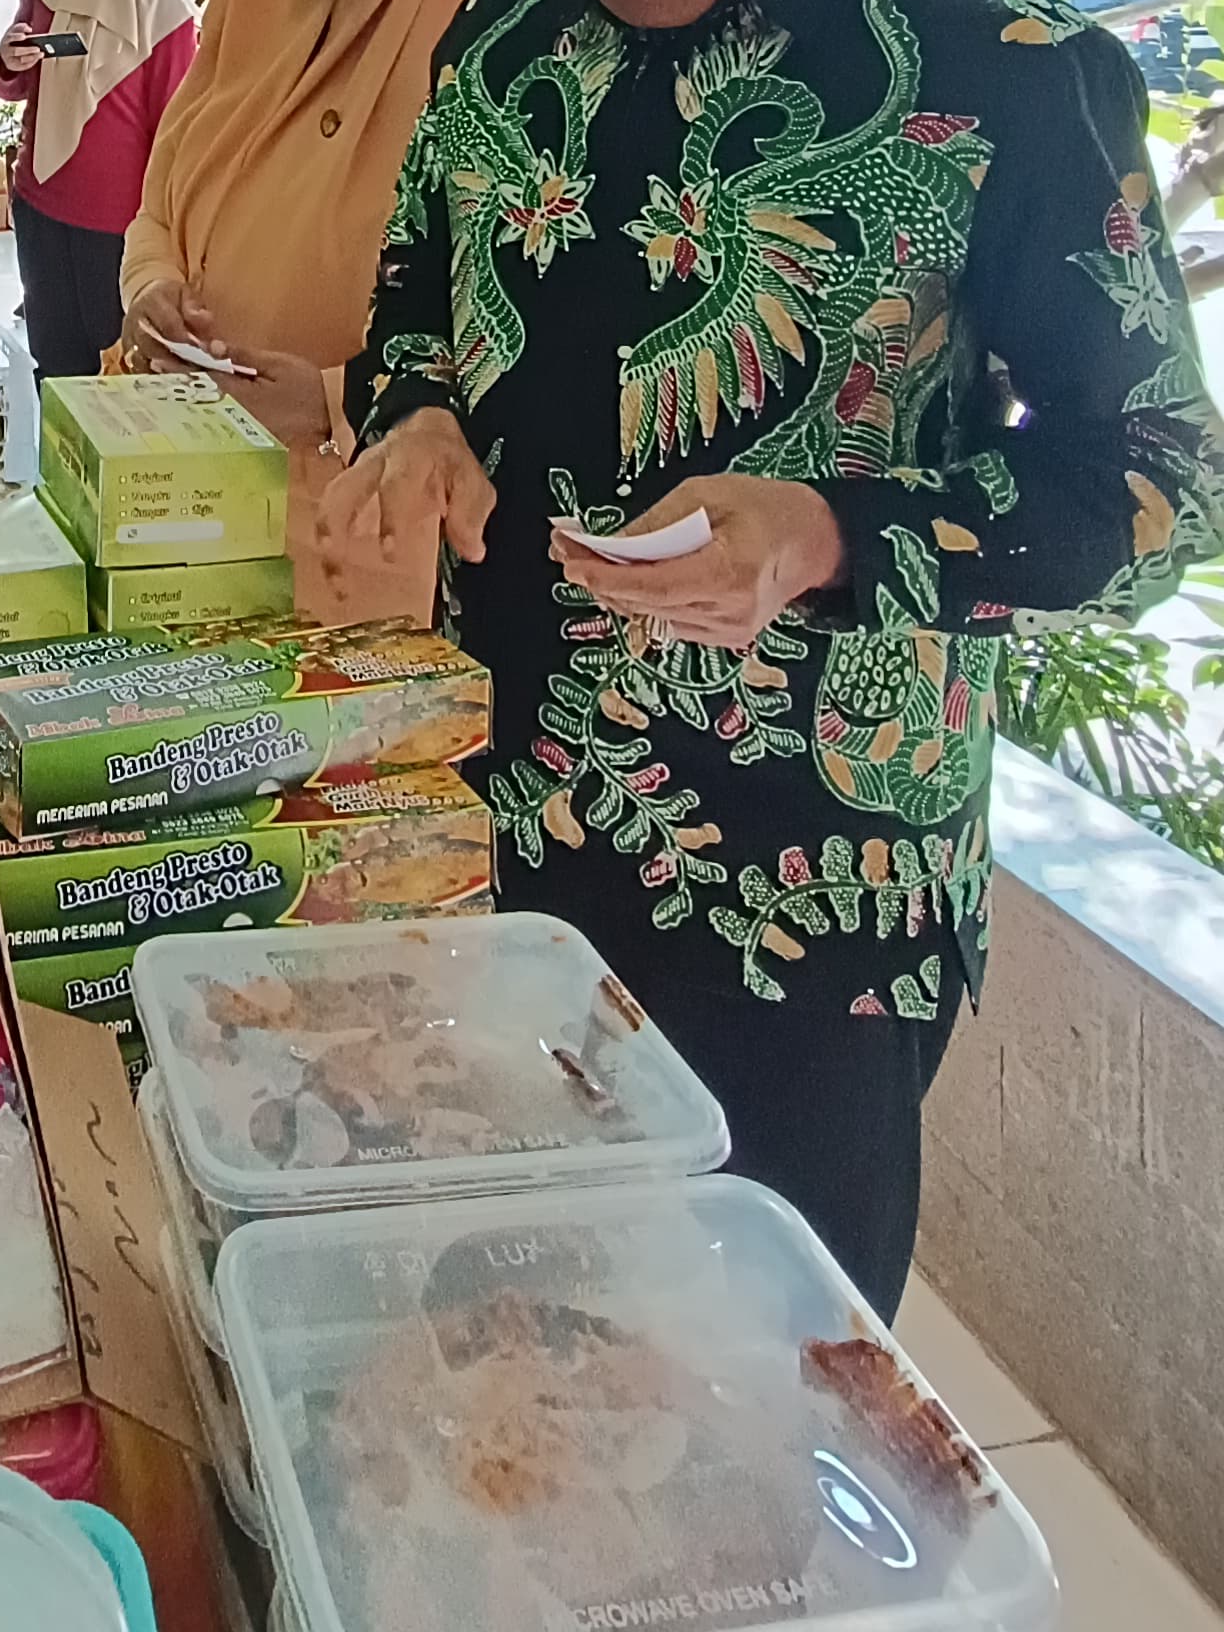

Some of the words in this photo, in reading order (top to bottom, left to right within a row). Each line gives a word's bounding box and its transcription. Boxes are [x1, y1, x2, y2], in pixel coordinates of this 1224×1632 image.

[48, 636, 128, 658] Presto
[24, 670, 143, 705] Bandeng
[140, 653, 226, 679] Presto
[110, 686, 137, 704] &
[138, 658, 275, 697] Otak-Otak
[106, 738, 206, 784] Bandeng
[207, 712, 280, 751] Presto
[171, 765, 192, 793] &
[193, 729, 308, 787] Otak-Otak
[36, 800, 108, 825] MENERIMA
[110, 791, 169, 815] PESANAN
[57, 861, 167, 910] Bandeng
[167, 843, 249, 882] Presto
[128, 892, 149, 924] &
[153, 864, 280, 916] Otak-Otak
[6, 926, 59, 947] NERIMA
[62, 920, 124, 941] PESANAN
[65, 966, 132, 1009] Band
[574, 1594, 698, 1629] CROWAVE
[697, 1582, 770, 1613] OVEN
